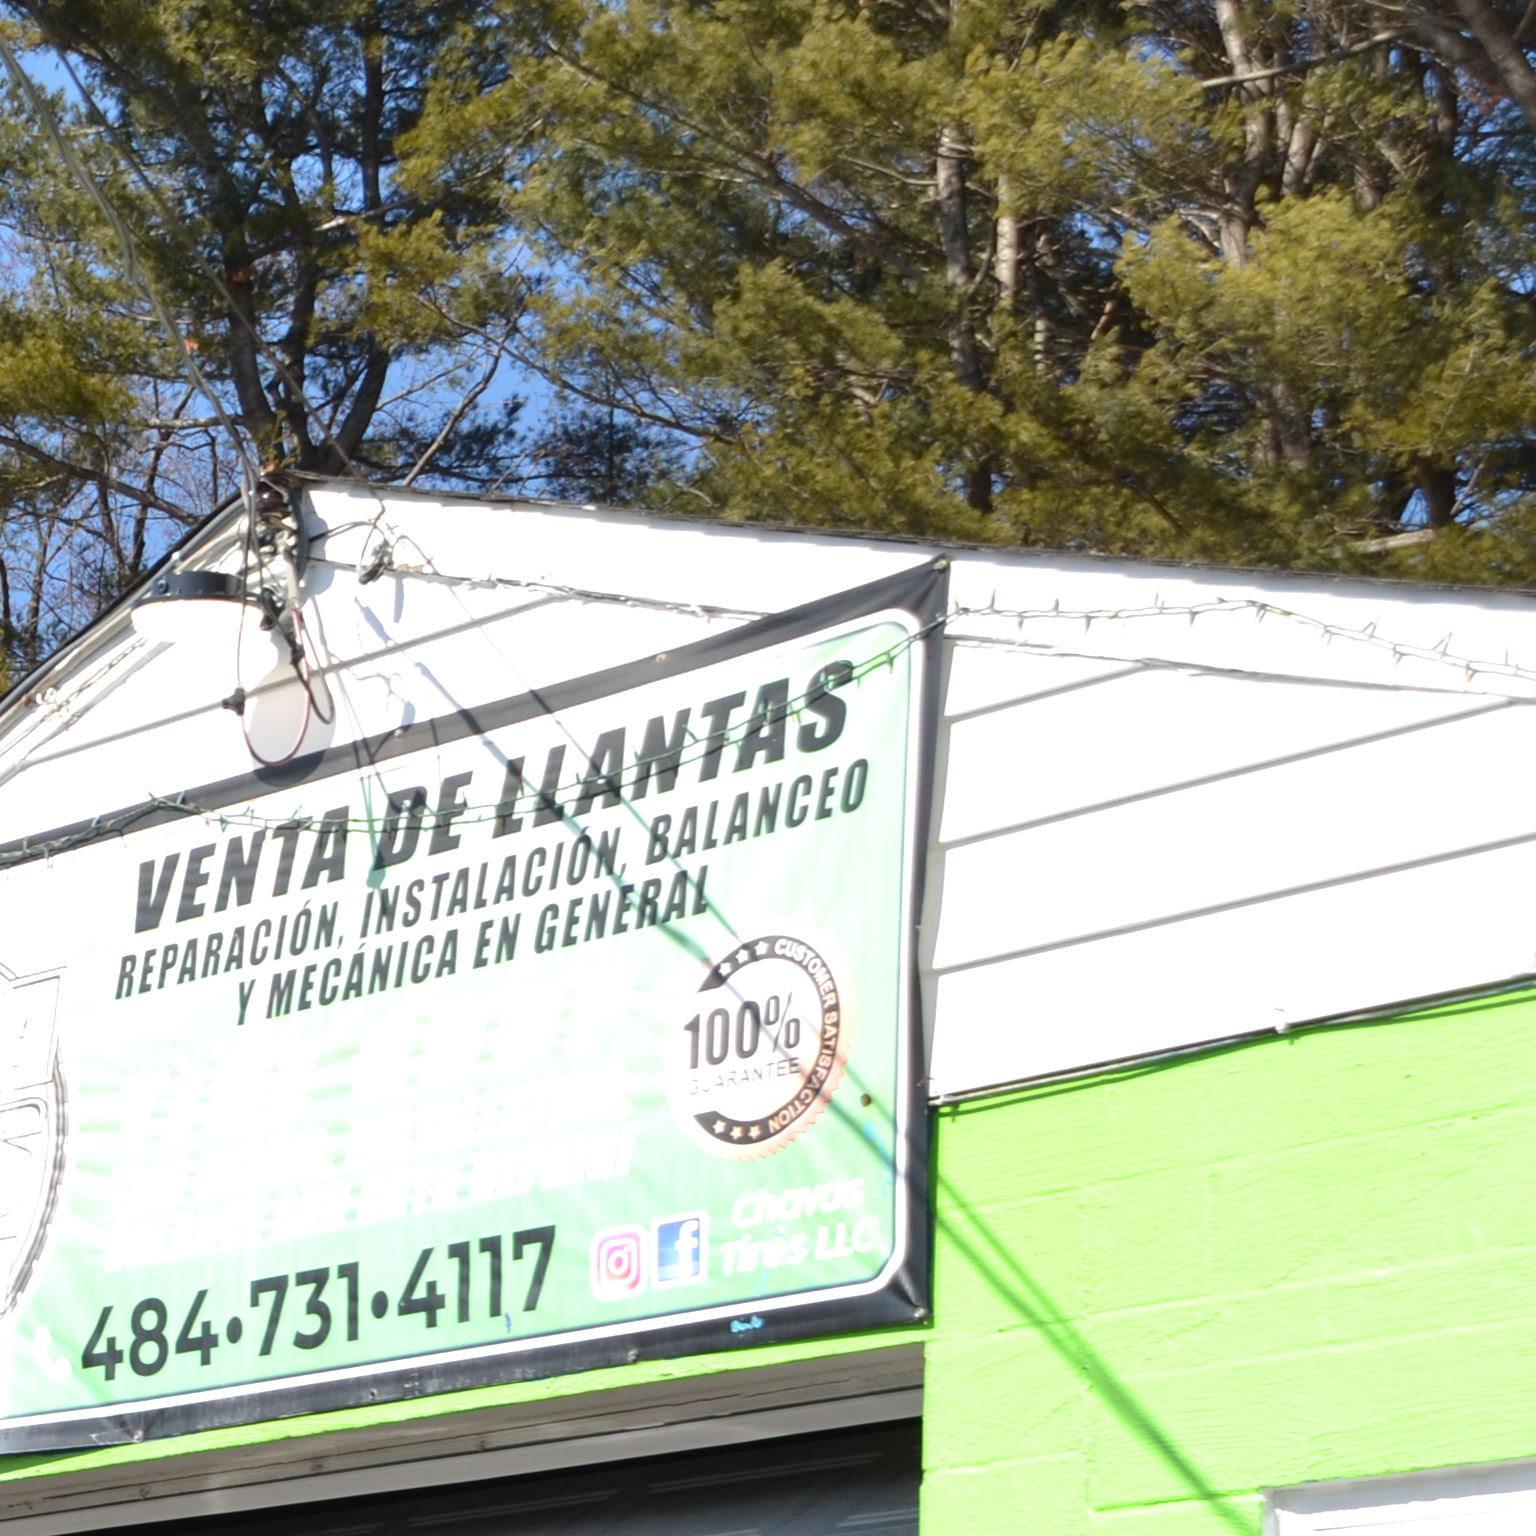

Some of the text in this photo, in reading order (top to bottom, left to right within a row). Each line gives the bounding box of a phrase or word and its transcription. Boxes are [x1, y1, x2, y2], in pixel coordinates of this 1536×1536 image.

[134, 659, 854, 934] VENTA DE LLANTAS
[114, 758, 869, 1000] REPARACIÓN, INSTALACIÓN, BALANCEO
[236, 864, 710, 1026] Y MECÁNICA EN GENERAL
[683, 991, 801, 1070] 100%
[688, 1056, 801, 1095] GUARANTEE
[767, 938, 838, 1134] CUSTOMER SATISFACTION
[719, 1216, 880, 1276] Tires LLC
[731, 1177, 866, 1229] Chavos
